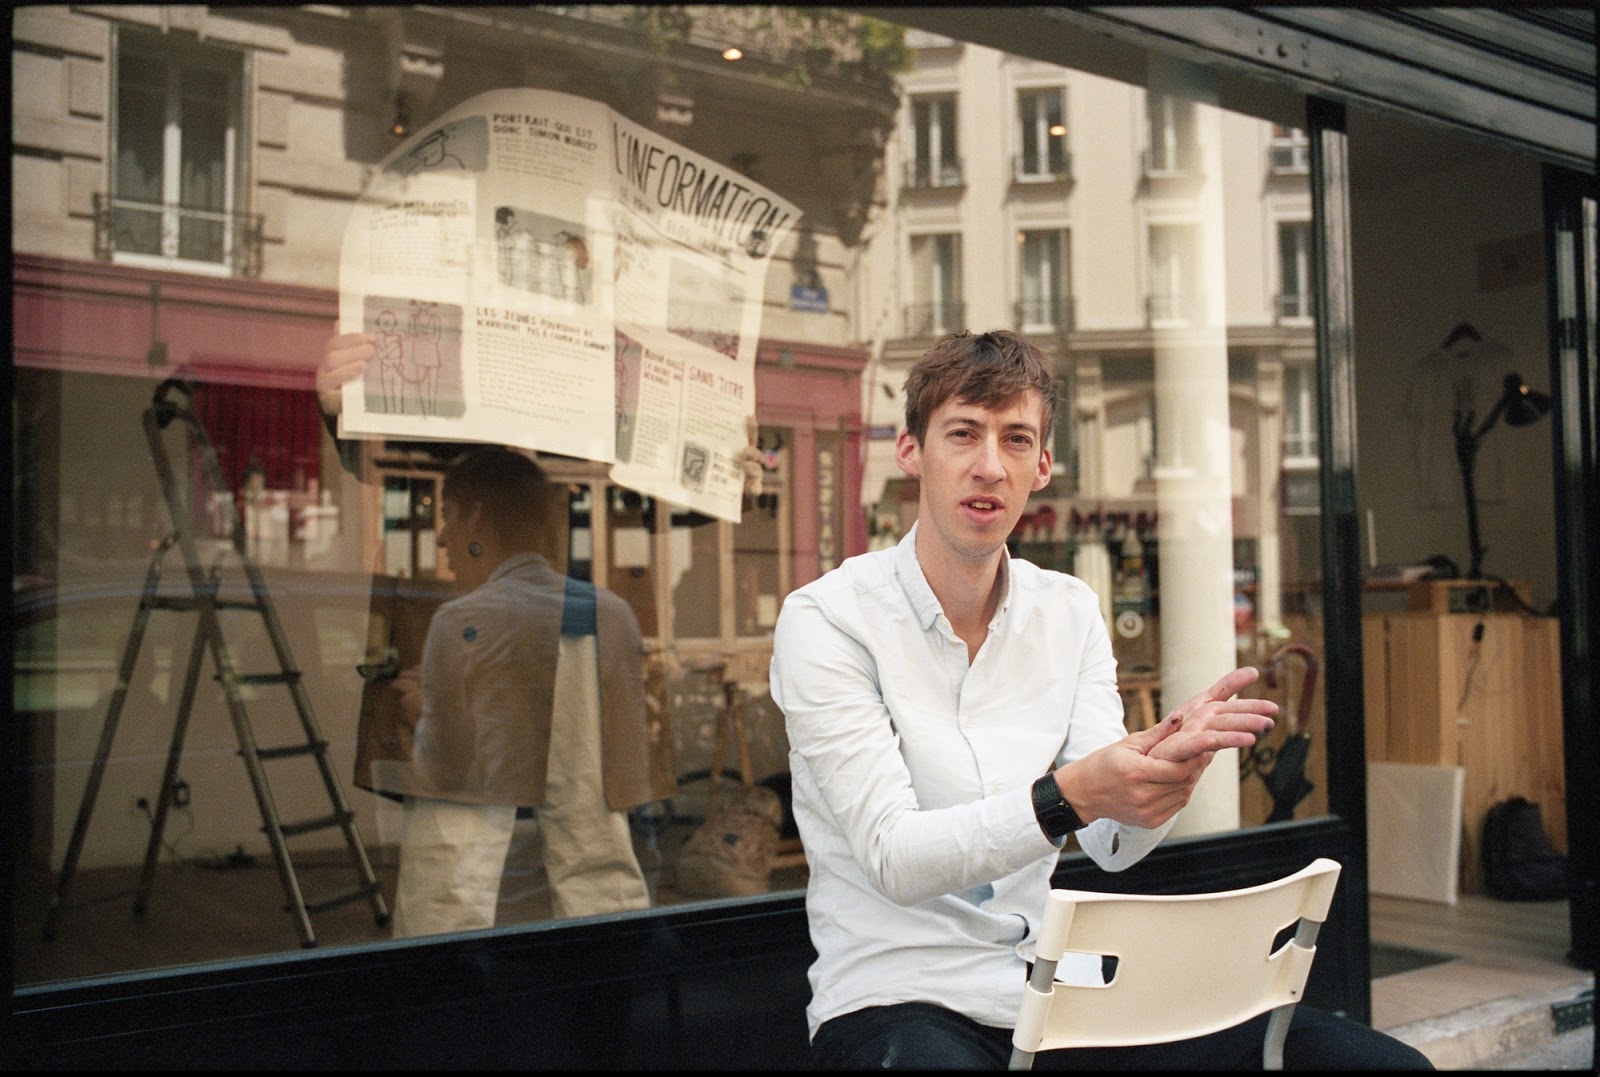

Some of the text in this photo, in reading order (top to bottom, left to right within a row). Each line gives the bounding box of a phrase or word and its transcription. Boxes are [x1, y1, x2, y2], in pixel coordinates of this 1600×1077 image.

[493, 113, 548, 127] PORTRAIT
[476, 306, 497, 319] LES
[689, 365, 714, 388] SANS
[718, 375, 744, 400] TITRE
